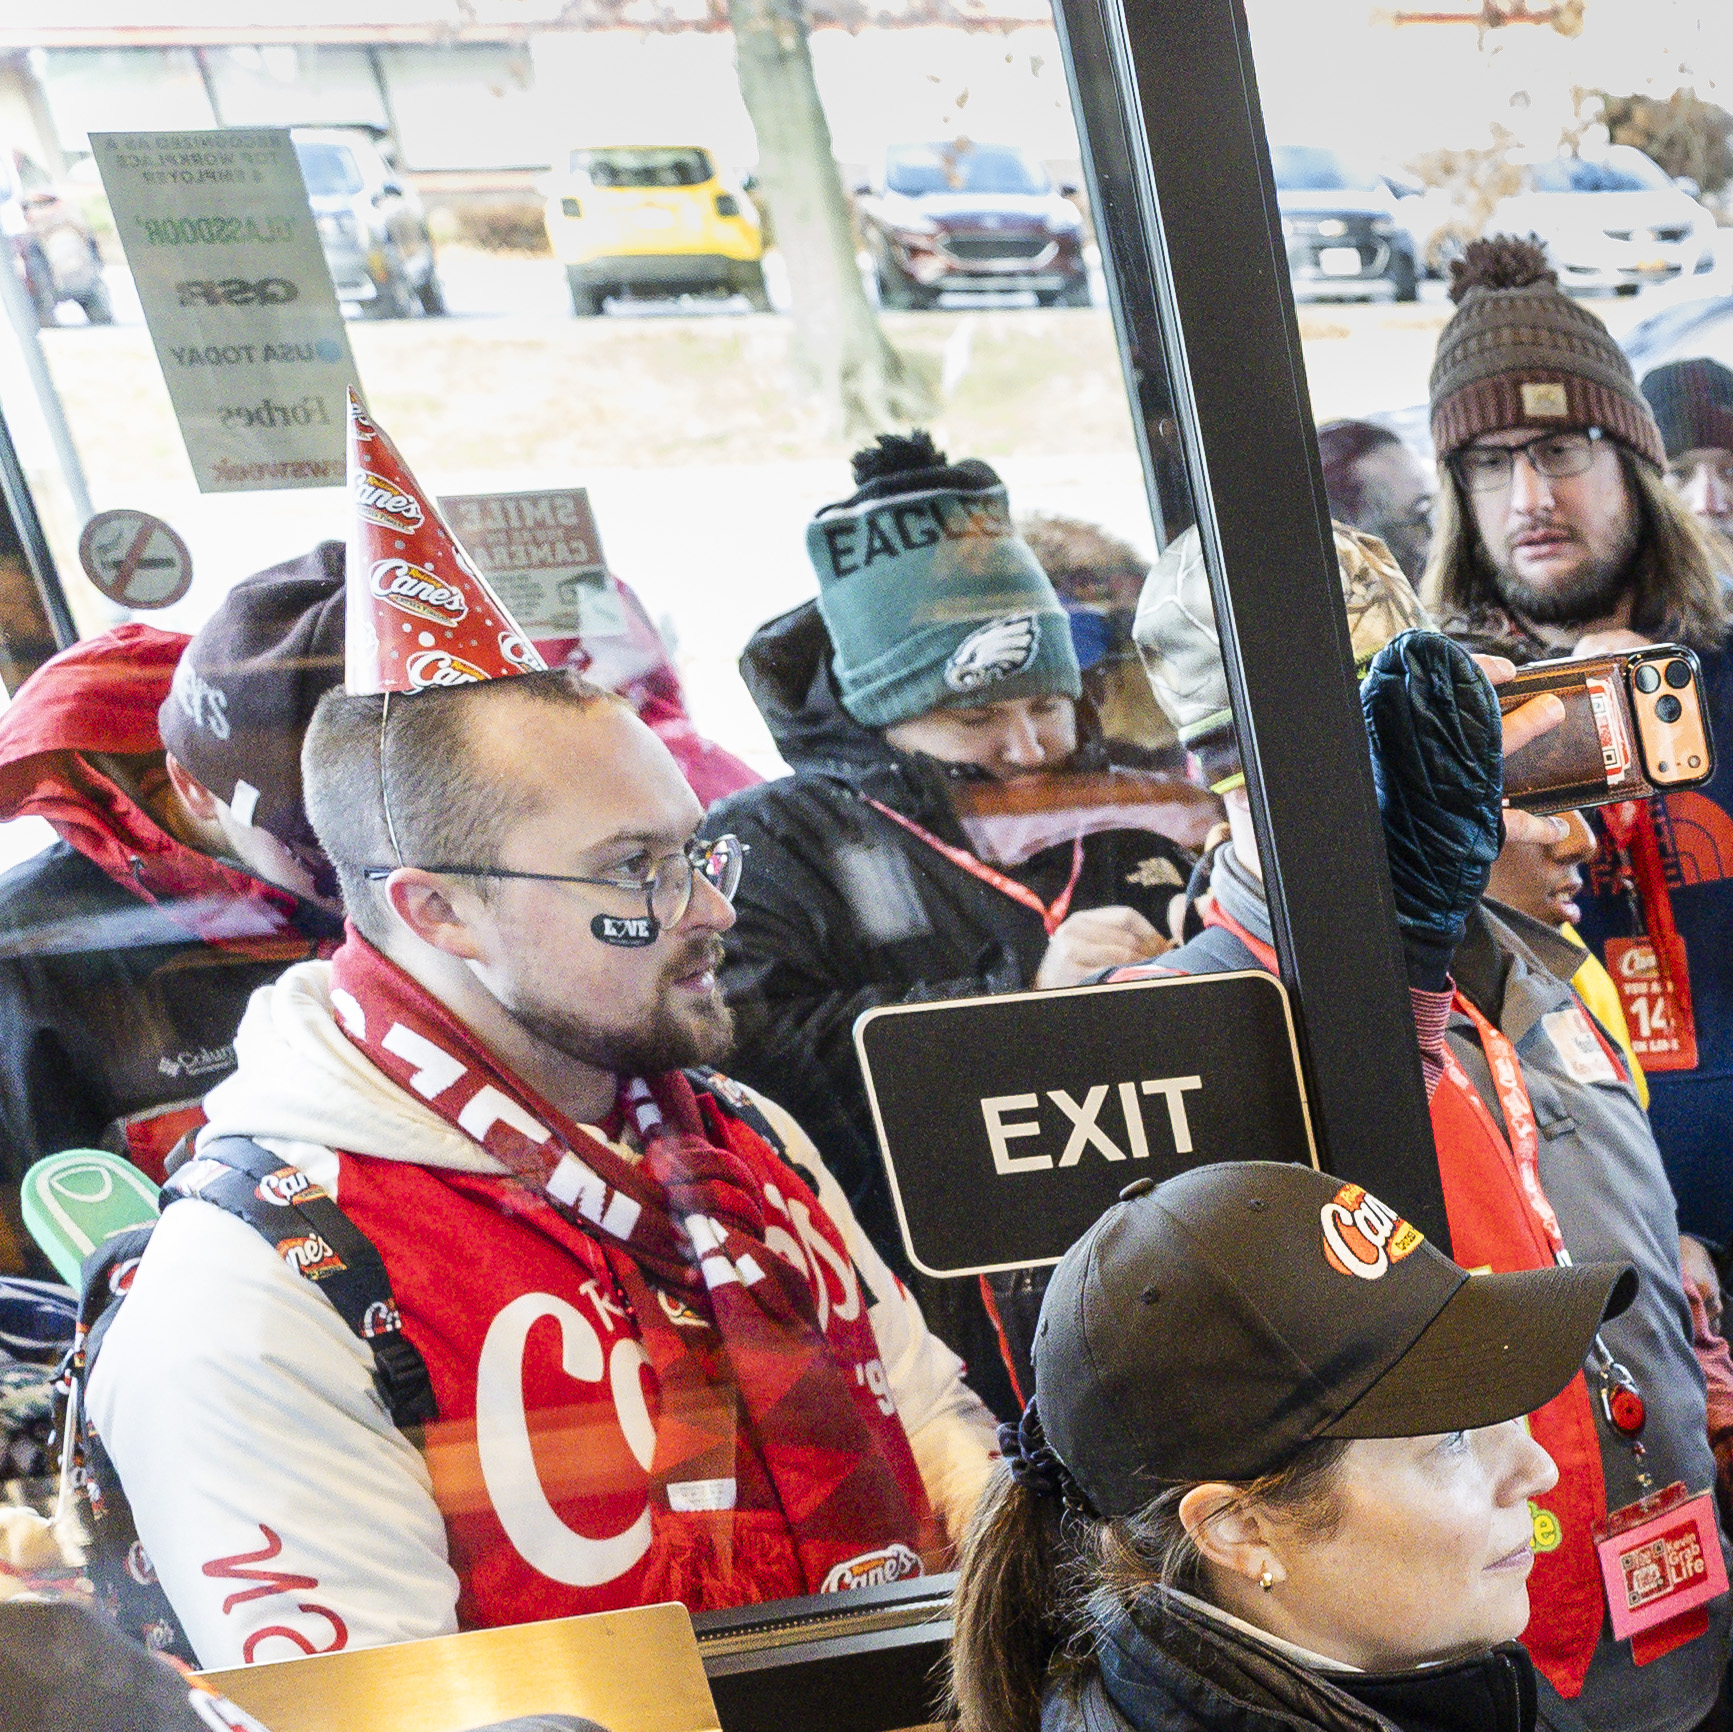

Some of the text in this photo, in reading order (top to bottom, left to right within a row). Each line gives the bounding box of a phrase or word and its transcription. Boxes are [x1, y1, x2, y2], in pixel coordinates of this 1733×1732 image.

[824, 497, 1007, 579] EAGLES
[371, 558, 466, 611] Cane's
[1629, 996, 1676, 1038] 14
[980, 1075, 1203, 1176] EXIT
[1670, 1557, 1705, 1584] Life
